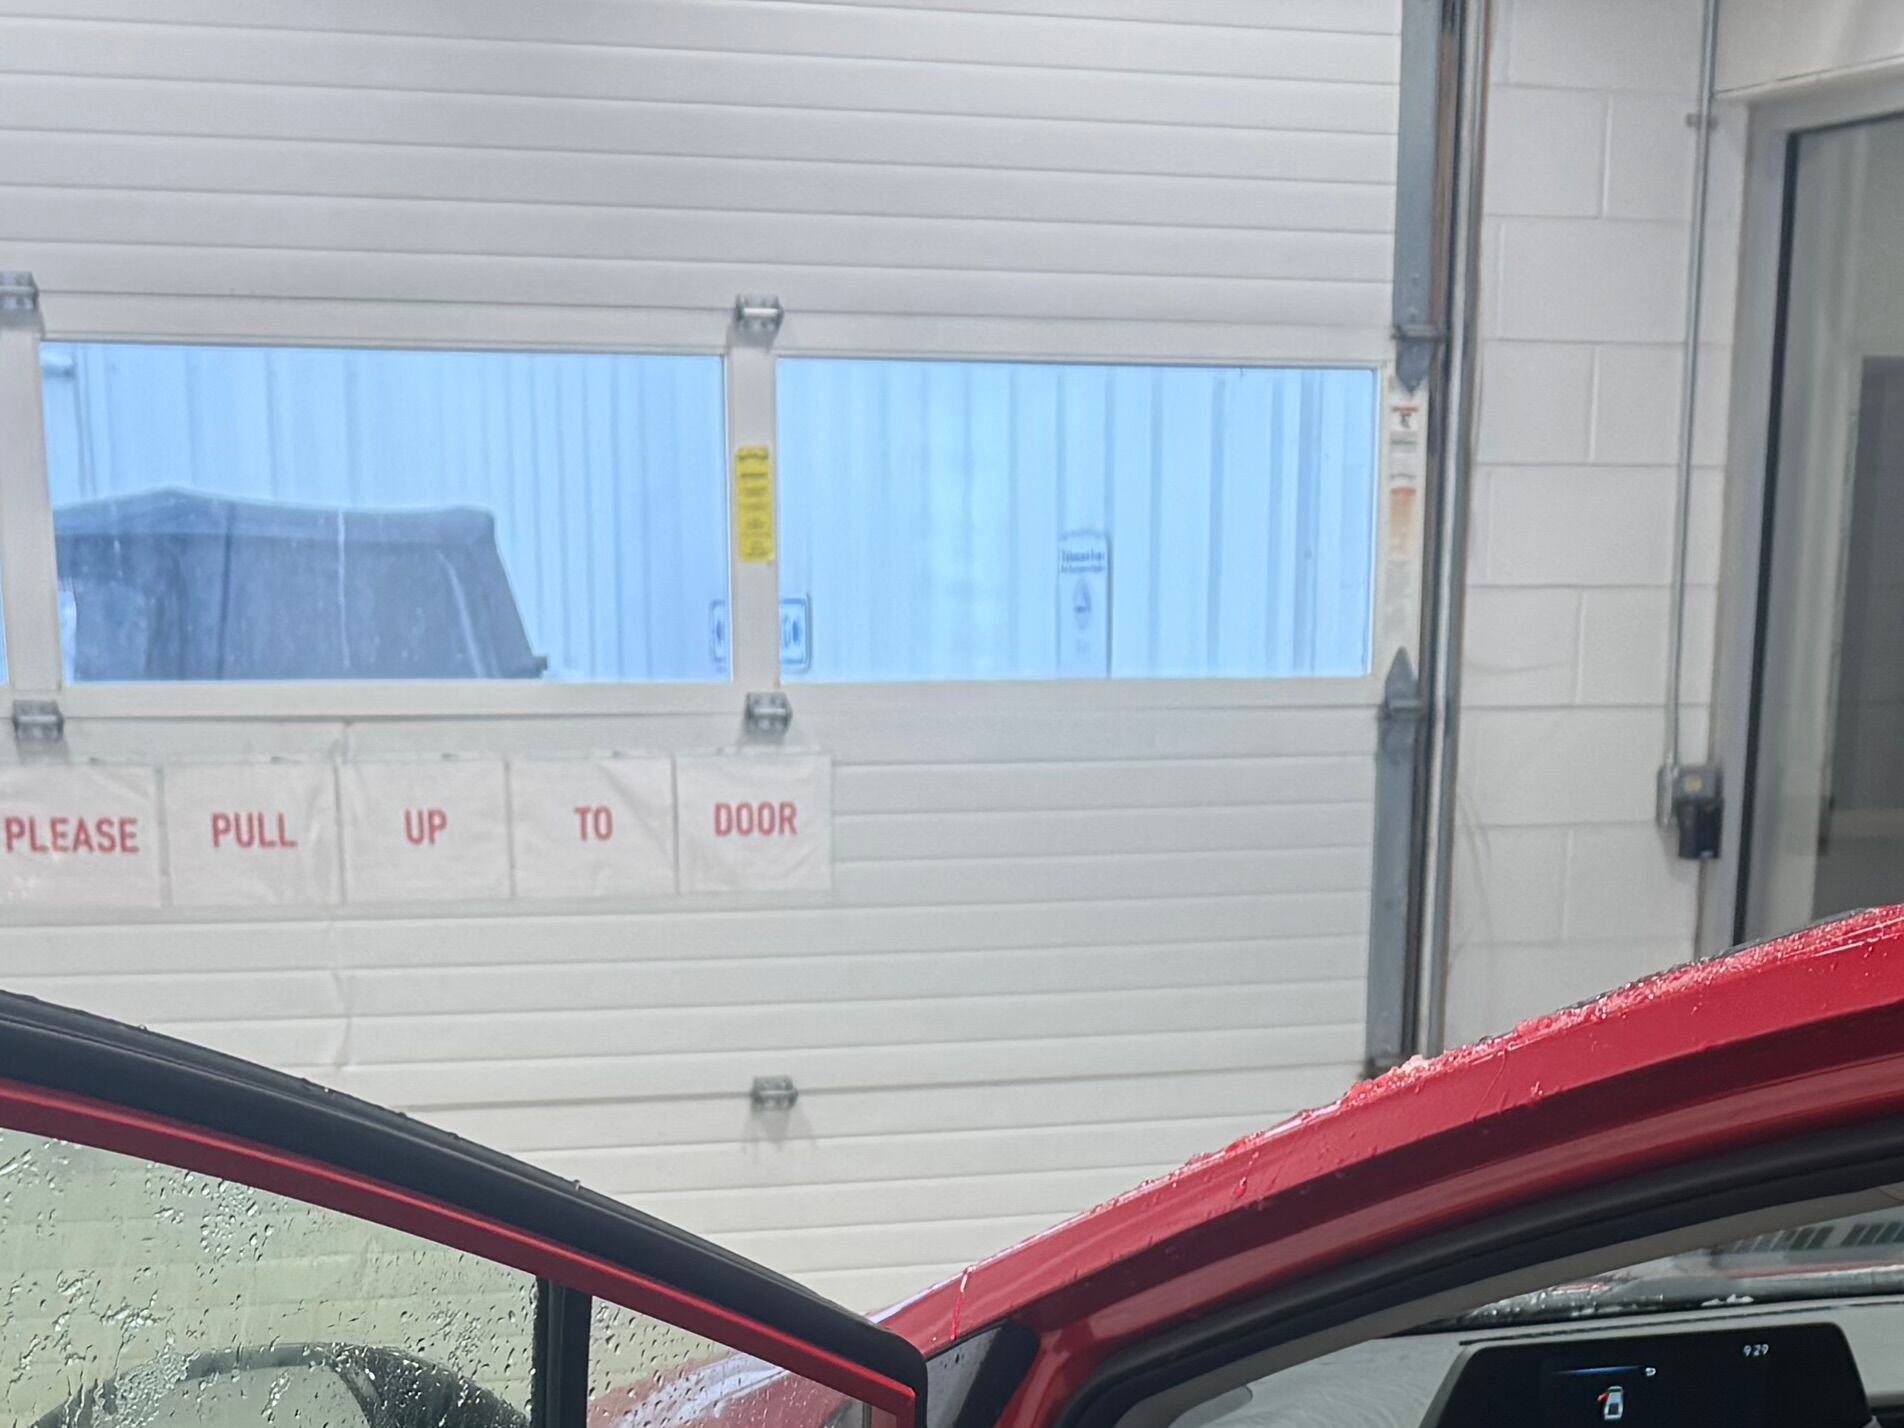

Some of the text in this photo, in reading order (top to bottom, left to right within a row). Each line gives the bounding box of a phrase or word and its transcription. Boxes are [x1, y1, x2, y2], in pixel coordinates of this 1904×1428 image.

[4, 801, 798, 853] PLEASE PULL UP TO DOOR
[1744, 1344, 1769, 1356] 929
